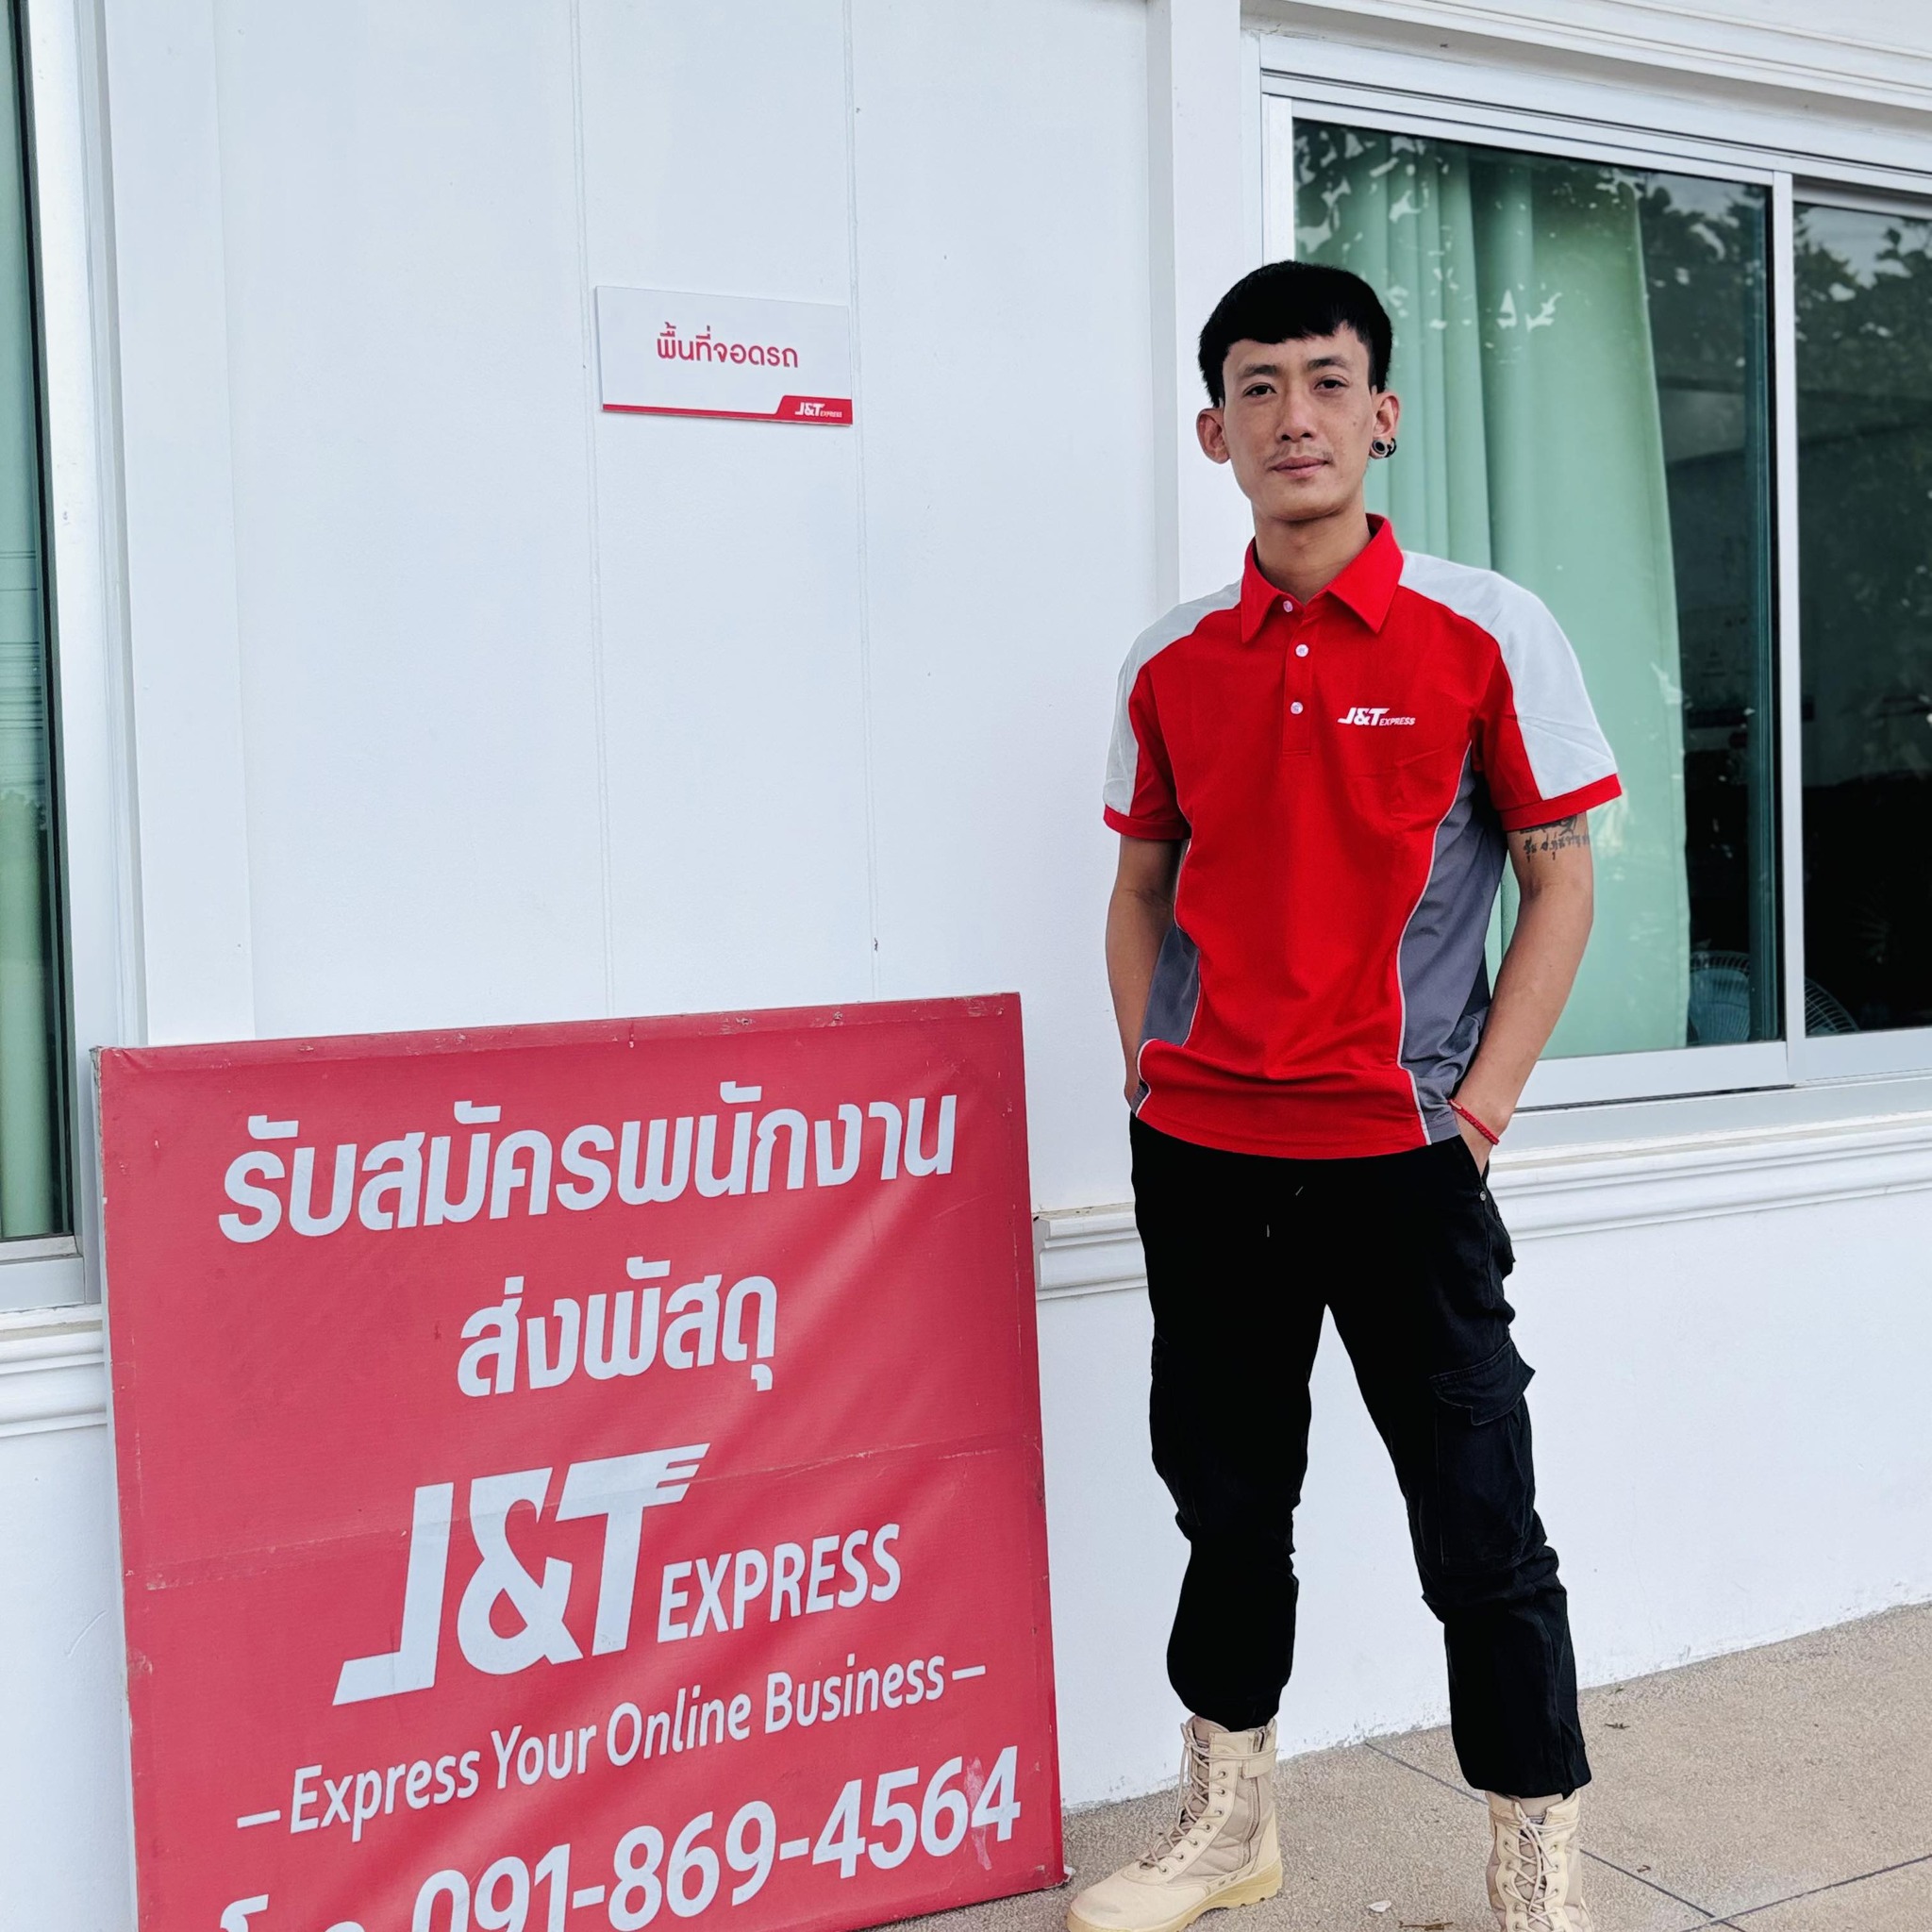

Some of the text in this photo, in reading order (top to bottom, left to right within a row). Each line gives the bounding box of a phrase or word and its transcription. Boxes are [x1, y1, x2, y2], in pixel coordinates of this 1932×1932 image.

[656, 322, 798, 368] พื้นที่จอดรถ
[794, 402, 825, 417] J&T
[1337, 708, 1416, 726] J&T EXPRESS
[218, 1080, 958, 1243] รับสมัครพนักงาน
[457, 1256, 777, 1397] ส่งพัสดุ
[332, 1443, 901, 1706] J&T EXPRESS
[491, 1724, 597, 1790] Your
[607, 1687, 752, 1766] Online
[411, 1745, 1021, 1932] 091-869-4564
